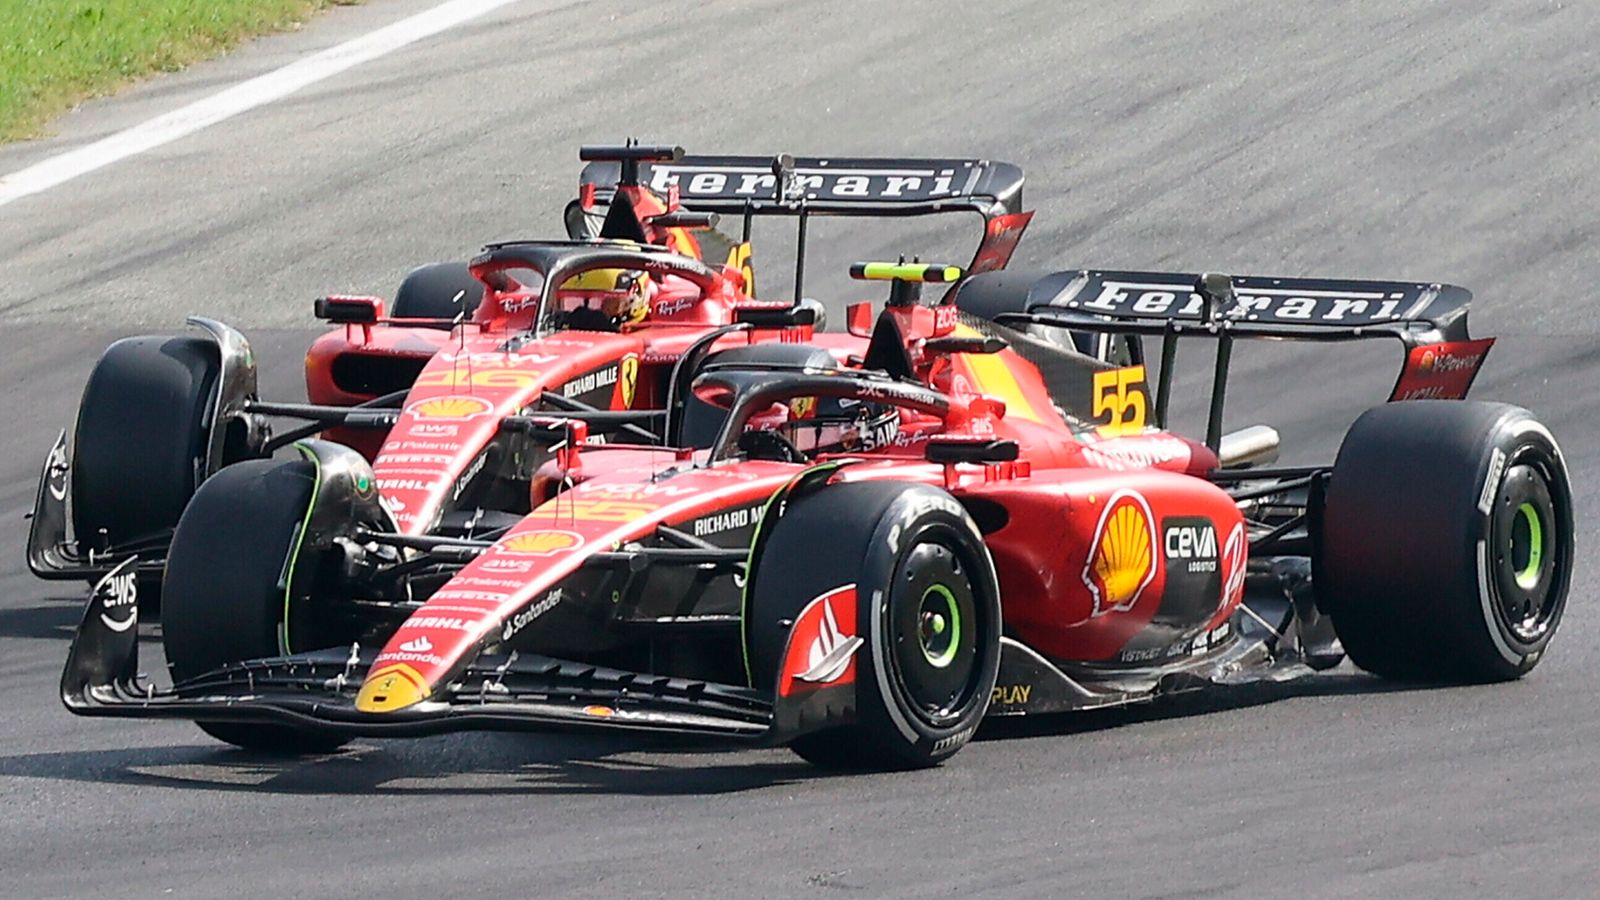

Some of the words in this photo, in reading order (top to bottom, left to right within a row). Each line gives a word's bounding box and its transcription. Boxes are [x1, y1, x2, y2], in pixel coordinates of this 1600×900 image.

[650, 165, 954, 197] Ferrari
[1083, 280, 1405, 320] Ferrari
[564, 373, 595, 398] RICHARD
[596, 365, 618, 389] MILLE
[1093, 365, 1145, 438] 55
[862, 416, 900, 452] SAIN
[694, 508, 749, 537] RICHARD
[513, 586, 563, 634] Santander
[992, 685, 1031, 704] PLAY
